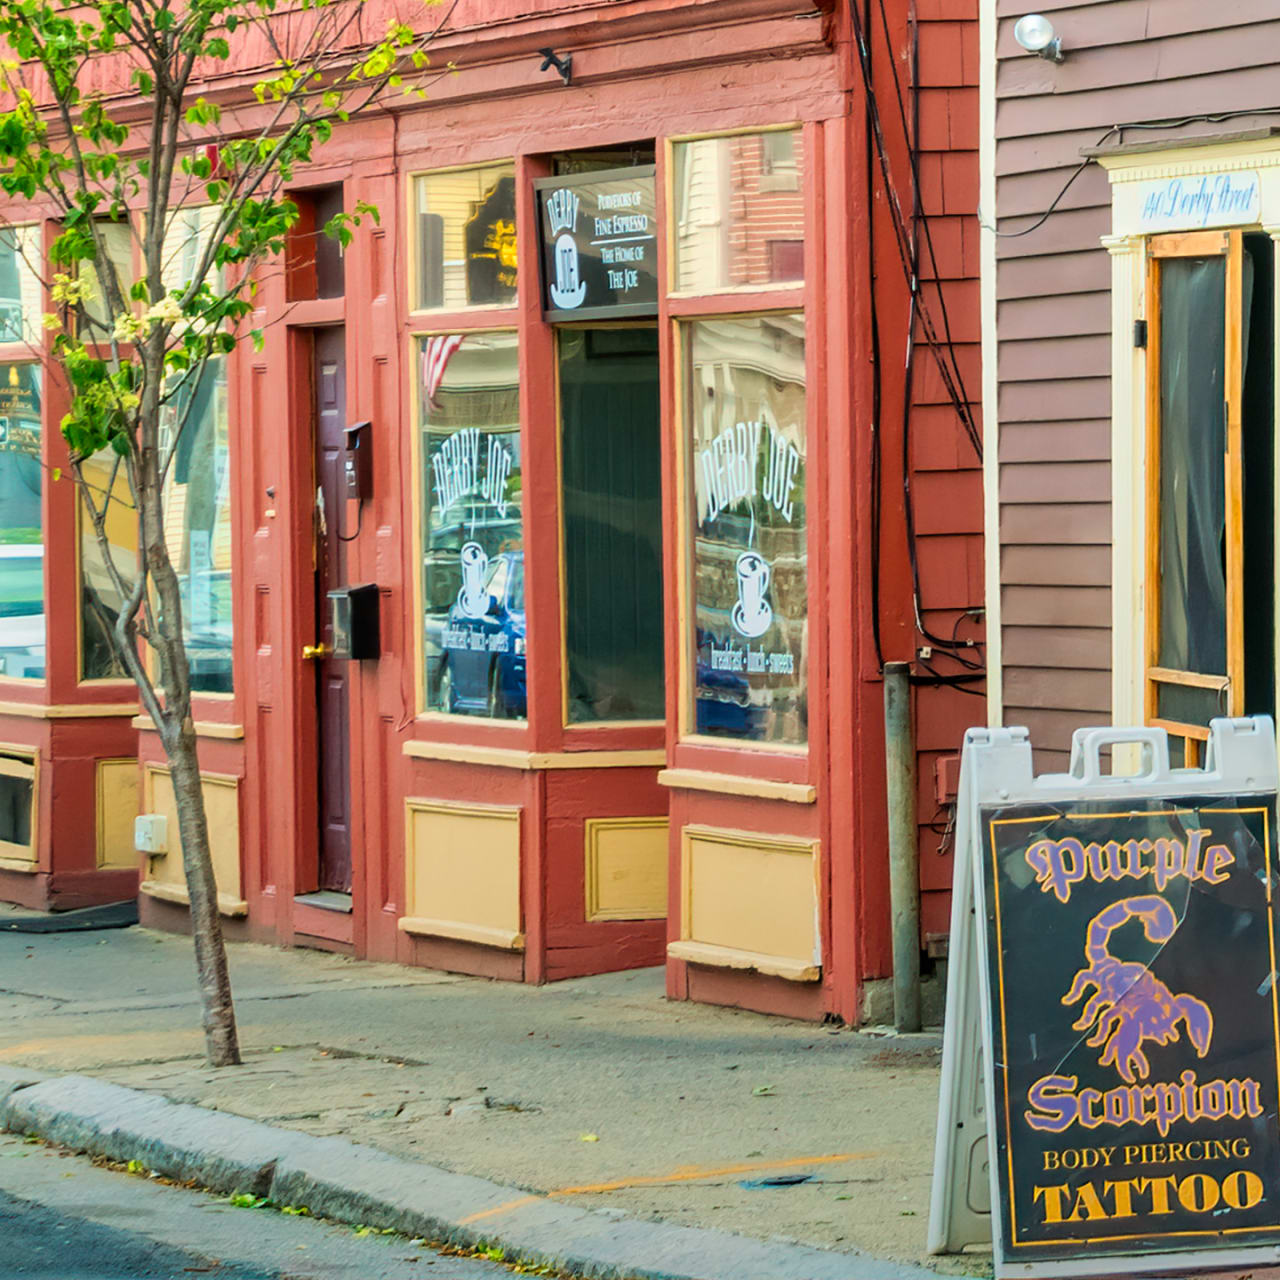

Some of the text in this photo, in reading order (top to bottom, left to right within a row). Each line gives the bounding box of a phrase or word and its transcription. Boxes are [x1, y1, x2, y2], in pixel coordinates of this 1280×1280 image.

[547, 189, 579, 237] DERBY
[433, 428, 511, 520] DERBY JOE
[701, 421, 799, 523] DERBY JOE
[1025, 829, 1235, 903] Purple
[1025, 1069, 1265, 1138] Scorpion
[1043, 1139, 1251, 1170] BODY PIERCING
[1033, 1169, 1265, 1224] TATTOO
